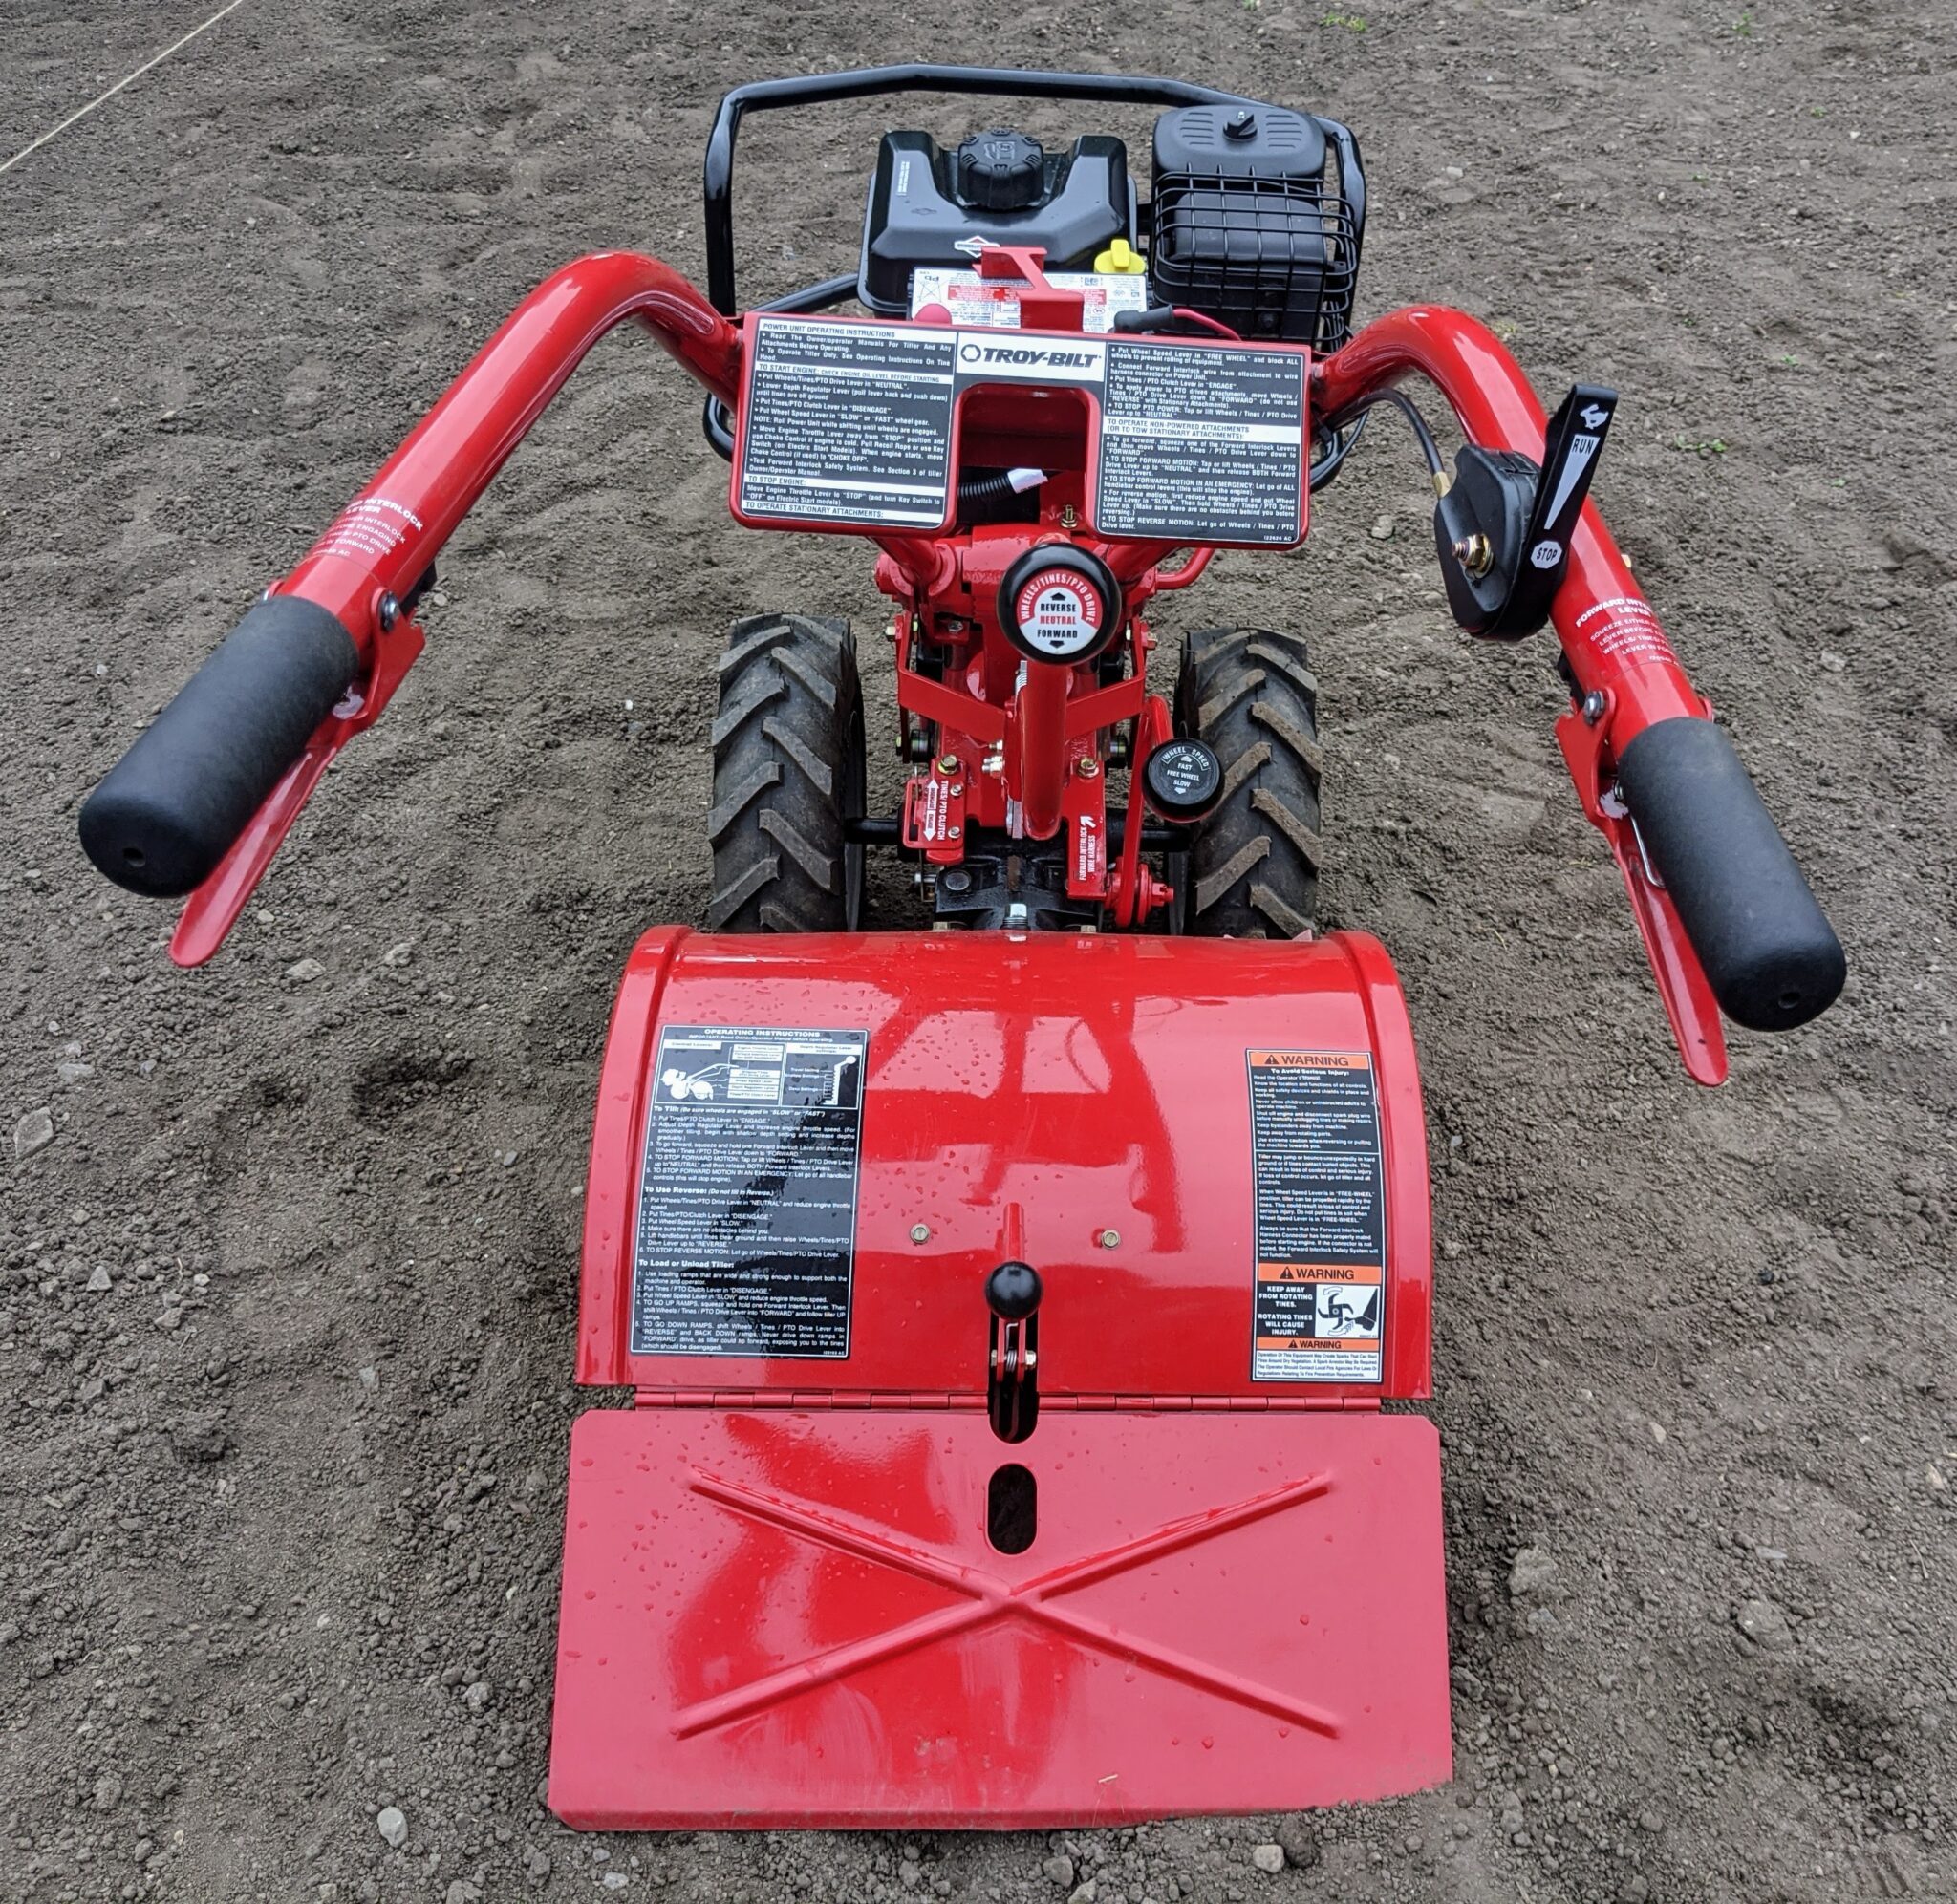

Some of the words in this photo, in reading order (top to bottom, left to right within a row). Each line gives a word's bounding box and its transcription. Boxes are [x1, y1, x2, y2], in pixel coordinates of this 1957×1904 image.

[846, 328, 894, 337] INSTRUCTIONS
[984, 348, 1097, 367] TROY-BILT
[774, 374, 827, 384] Wheels/Tines/PTO
[839, 422, 861, 430] shifting
[1149, 428, 1189, 436] STATIONARY
[1572, 436, 1594, 455] RUN
[365, 498, 424, 532] INTERLOCK
[756, 502, 786, 510] OPERATE
[789, 505, 830, 513] STATIONARY
[357, 524, 396, 546] ENGAGING
[365, 517, 406, 543] INTERLOCK
[336, 539, 375, 554] FORWARD
[352, 531, 368, 540] PTO
[369, 538, 391, 556] DRIVE
[1536, 547, 1557, 561] STOP
[1040, 603, 1076, 612] REVERSE
[1084, 593, 1097, 622] DRIVE
[1575, 598, 1625, 627] FORWARD
[1040, 616, 1076, 625] NEUTRAL
[1037, 629, 1077, 638] FORWARD
[1590, 620, 1623, 642] SQUEEZE
[1599, 629, 1624, 646] LEVER
[1621, 645, 1646, 655] LEVER
[1163, 746, 1186, 760] WHEEL
[1191, 749, 1209, 767] SPEED
[1181, 772, 1200, 781] WHEEL
[938, 815, 946, 840] CLUTCH
[1079, 855, 1087, 880] FORWARD
[1281, 1055, 1348, 1066] WARNING
[1296, 1269, 1353, 1280] WARNING
